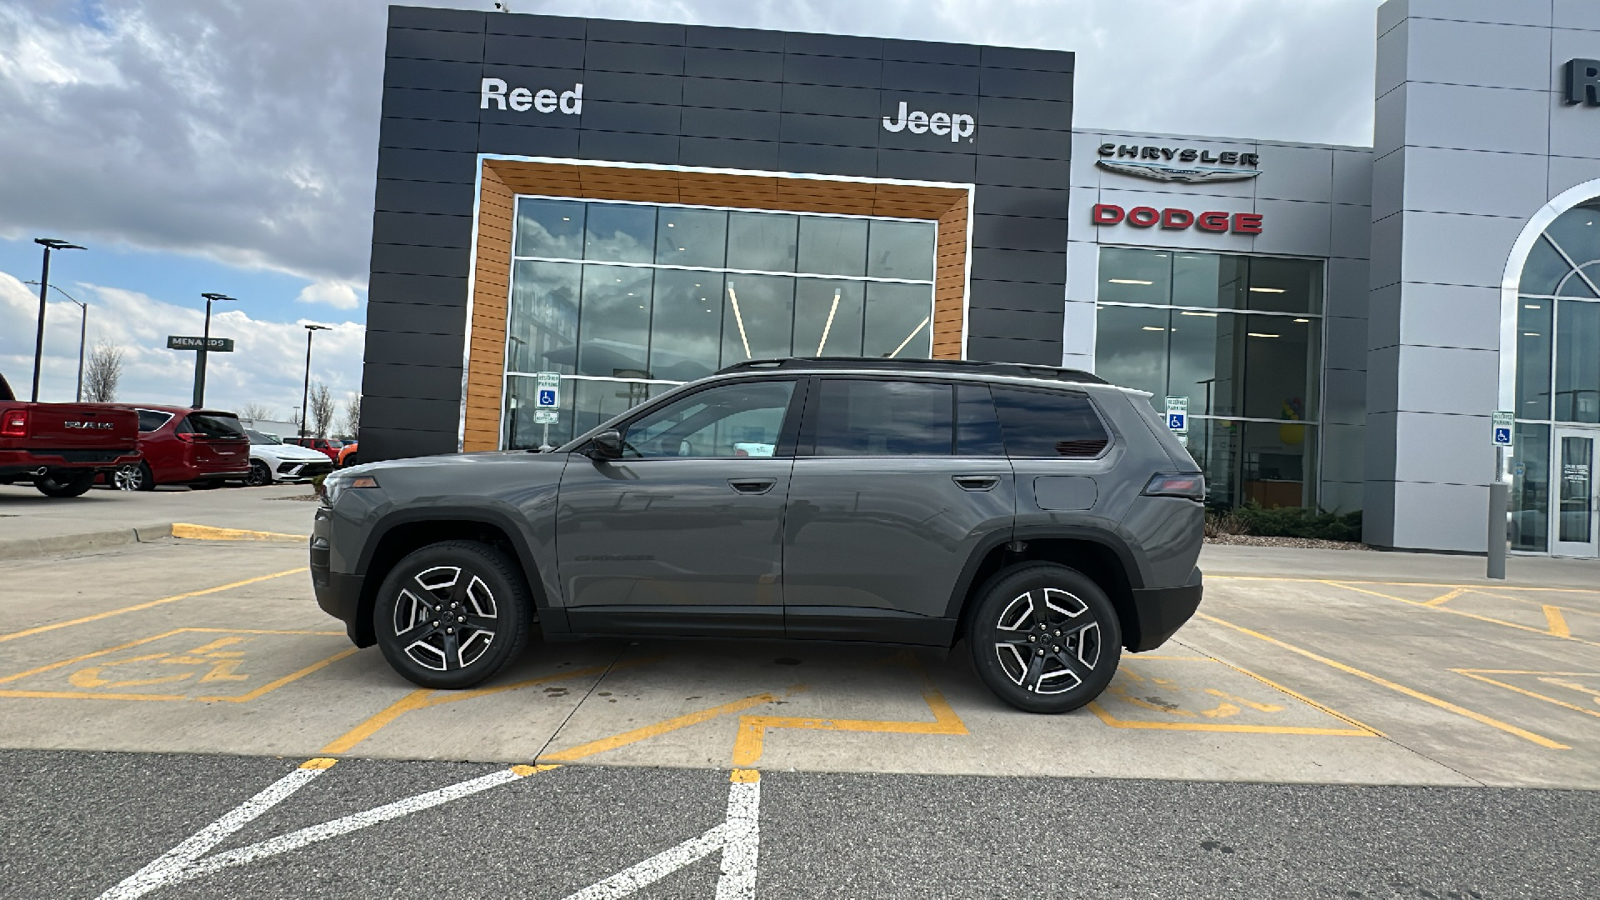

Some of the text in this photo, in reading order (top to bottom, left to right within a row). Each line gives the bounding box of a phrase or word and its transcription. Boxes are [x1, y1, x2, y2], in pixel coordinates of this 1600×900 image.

[480, 77, 583, 115] Reed
[883, 101, 976, 143] Jeep
[1098, 143, 1260, 166] CHRYSLER
[1092, 203, 1263, 235] DODGE
[64, 421, 114, 430] RAM
